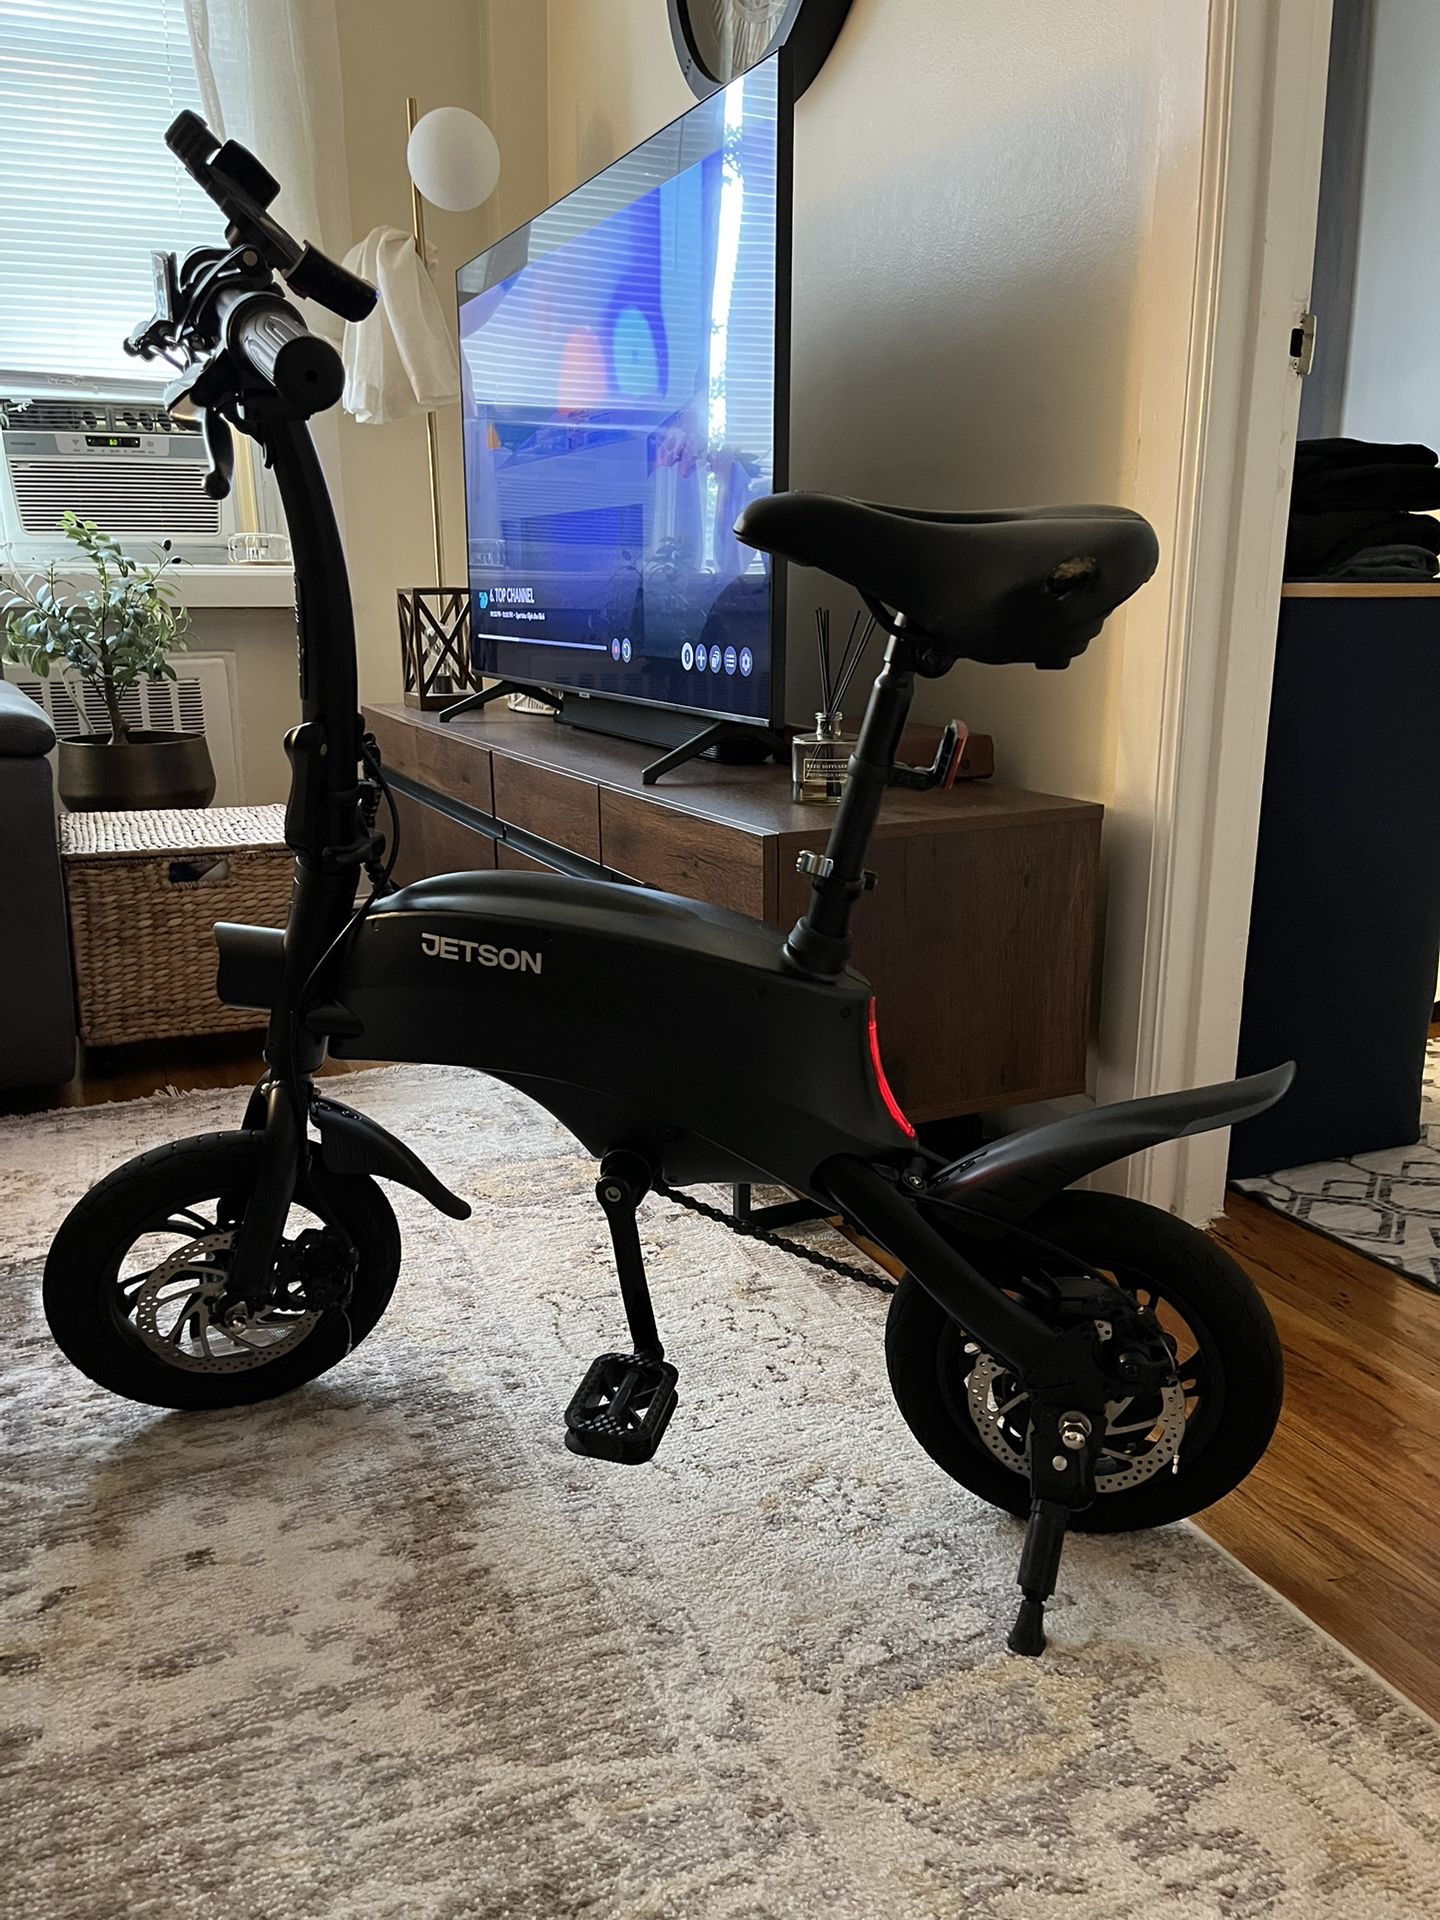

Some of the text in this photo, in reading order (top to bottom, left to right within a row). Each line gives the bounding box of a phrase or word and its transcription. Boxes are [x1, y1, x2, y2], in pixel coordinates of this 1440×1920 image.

[495, 587, 506, 603] TOP
[506, 587, 535, 603] CHANNEL
[421, 932, 542, 975] JETSON
